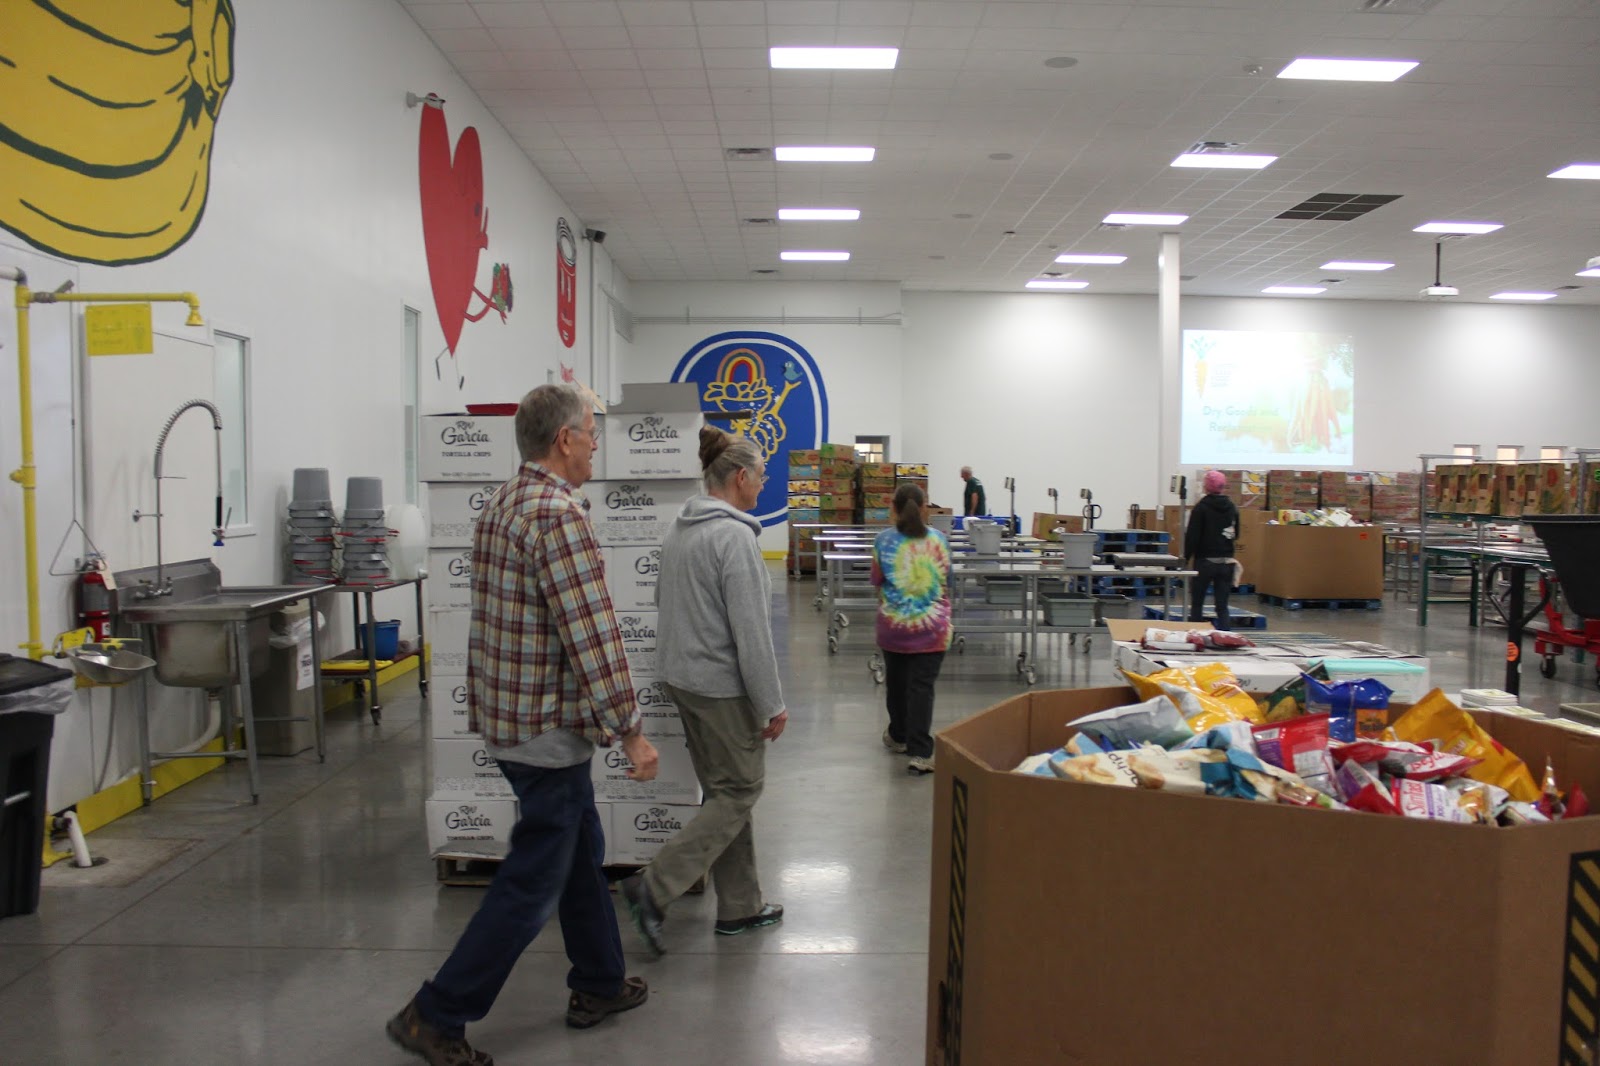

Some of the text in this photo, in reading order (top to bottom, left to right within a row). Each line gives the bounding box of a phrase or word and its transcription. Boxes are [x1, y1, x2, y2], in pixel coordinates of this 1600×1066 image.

[455, 420, 475, 430] RW
[643, 416, 664, 427] RW
[441, 426, 490, 445] Garcia
[628, 423, 678, 442] Garcia
[620, 484, 640, 494] RW
[605, 490, 655, 509] Garcia
[621, 616, 641, 626] RW
[459, 805, 478, 815] RW
[648, 807, 668, 817] RW
[445, 811, 492, 829] Garcia
[634, 813, 682, 831] Garcia
